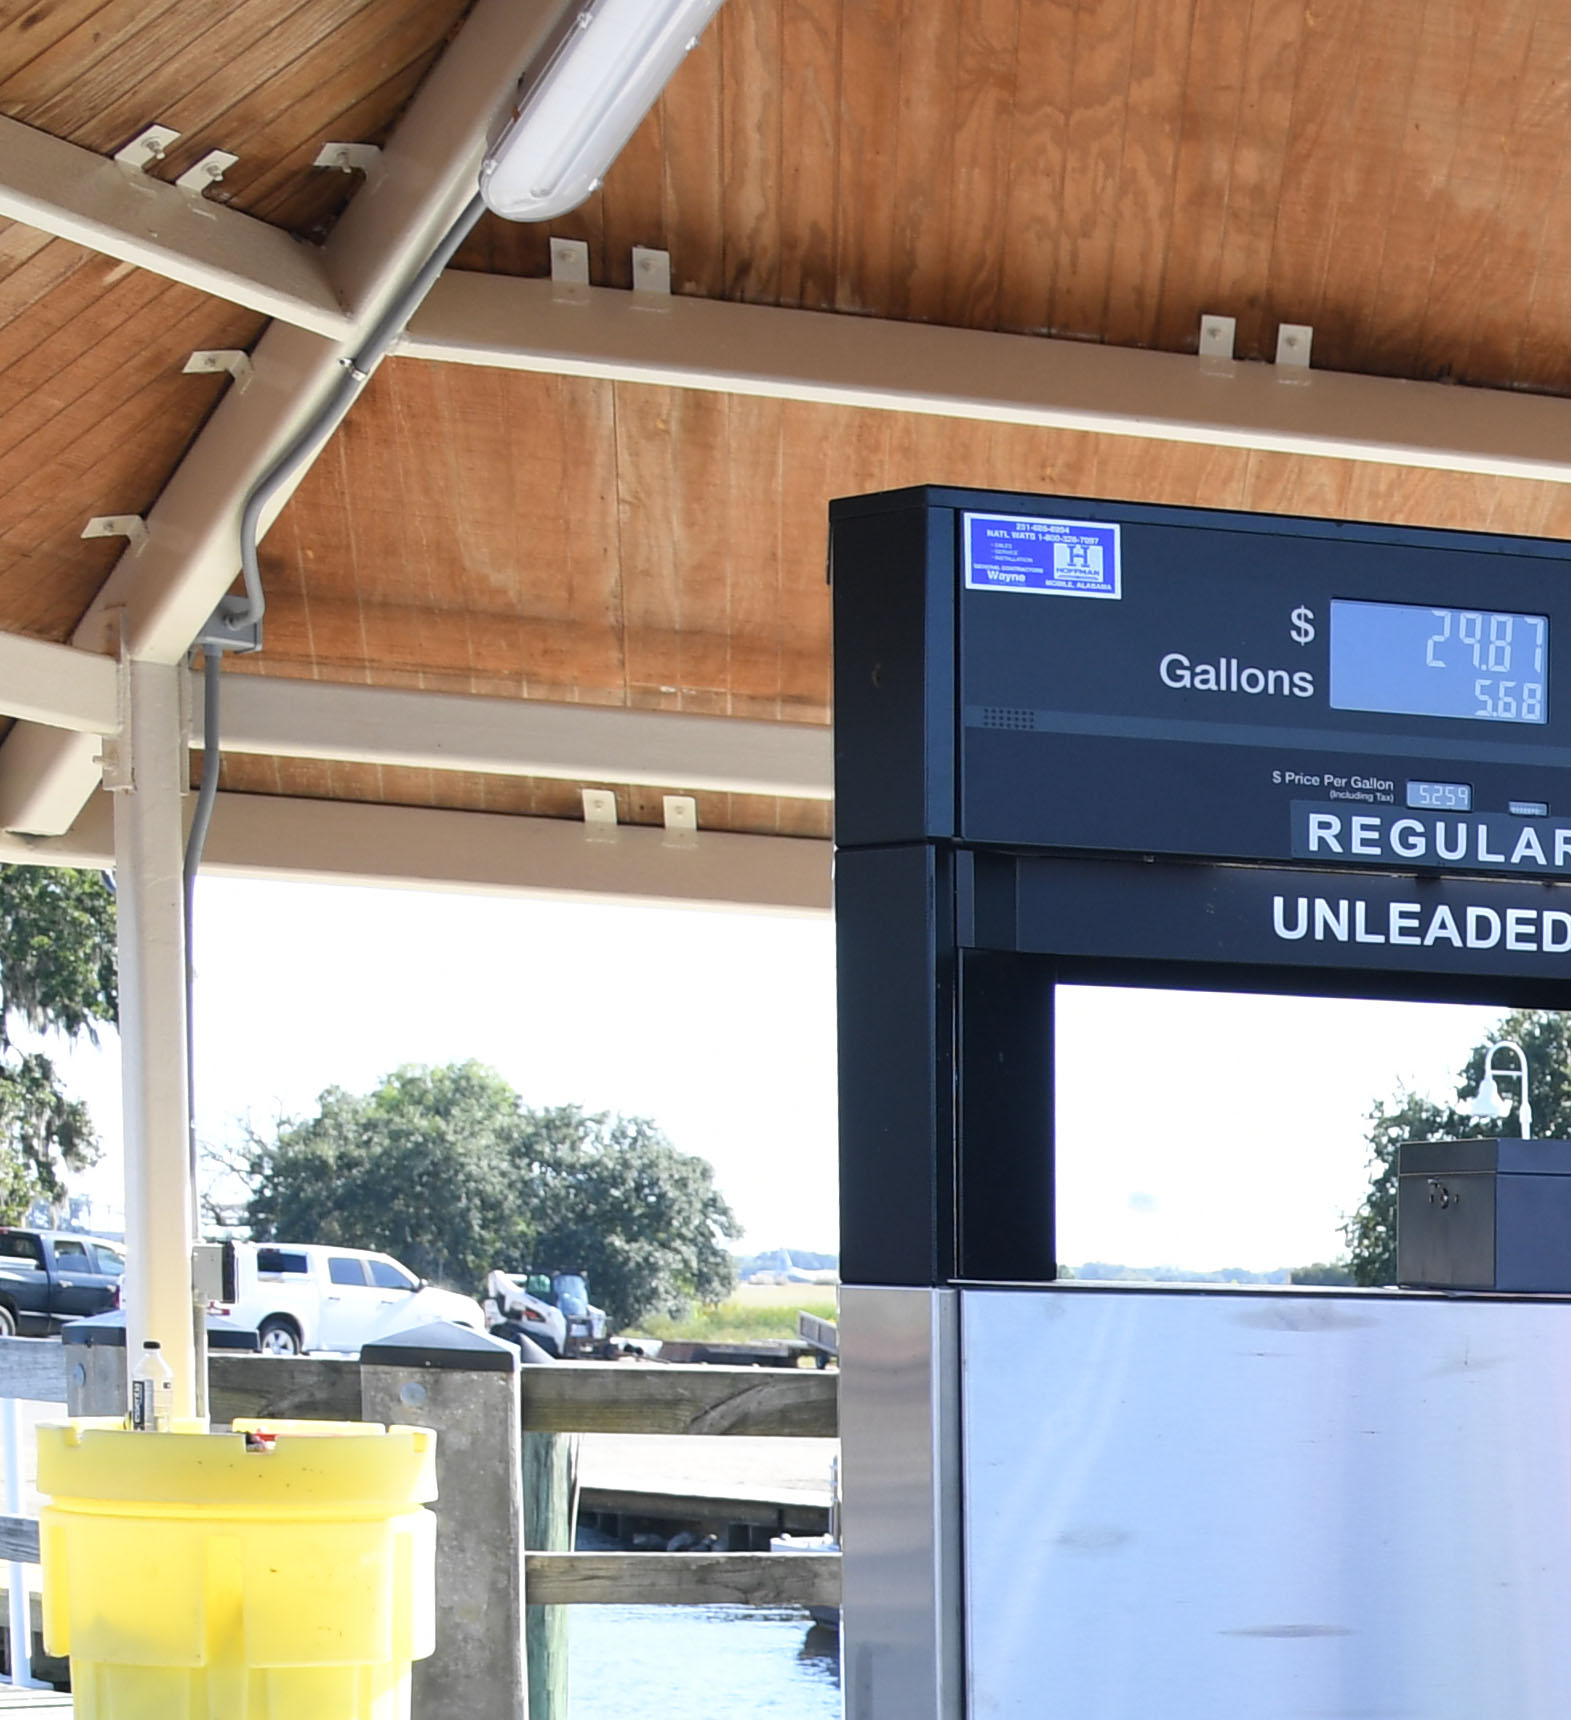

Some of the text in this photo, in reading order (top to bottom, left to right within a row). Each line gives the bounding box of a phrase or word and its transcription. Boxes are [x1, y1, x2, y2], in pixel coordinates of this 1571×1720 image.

[987, 569, 1026, 583] Wayne
[1056, 567, 1100, 576] HOFFMAN
[1290, 605, 1316, 646] $
[1426, 609, 1544, 673] 29.87
[1159, 651, 1315, 698] Gallons
[1474, 678, 1543, 721] 5.68
[1285, 771, 1320, 786] Price
[1324, 774, 1348, 787] Per
[1350, 776, 1394, 791] Gallon
[1329, 789, 1394, 804] (Including Tax)
